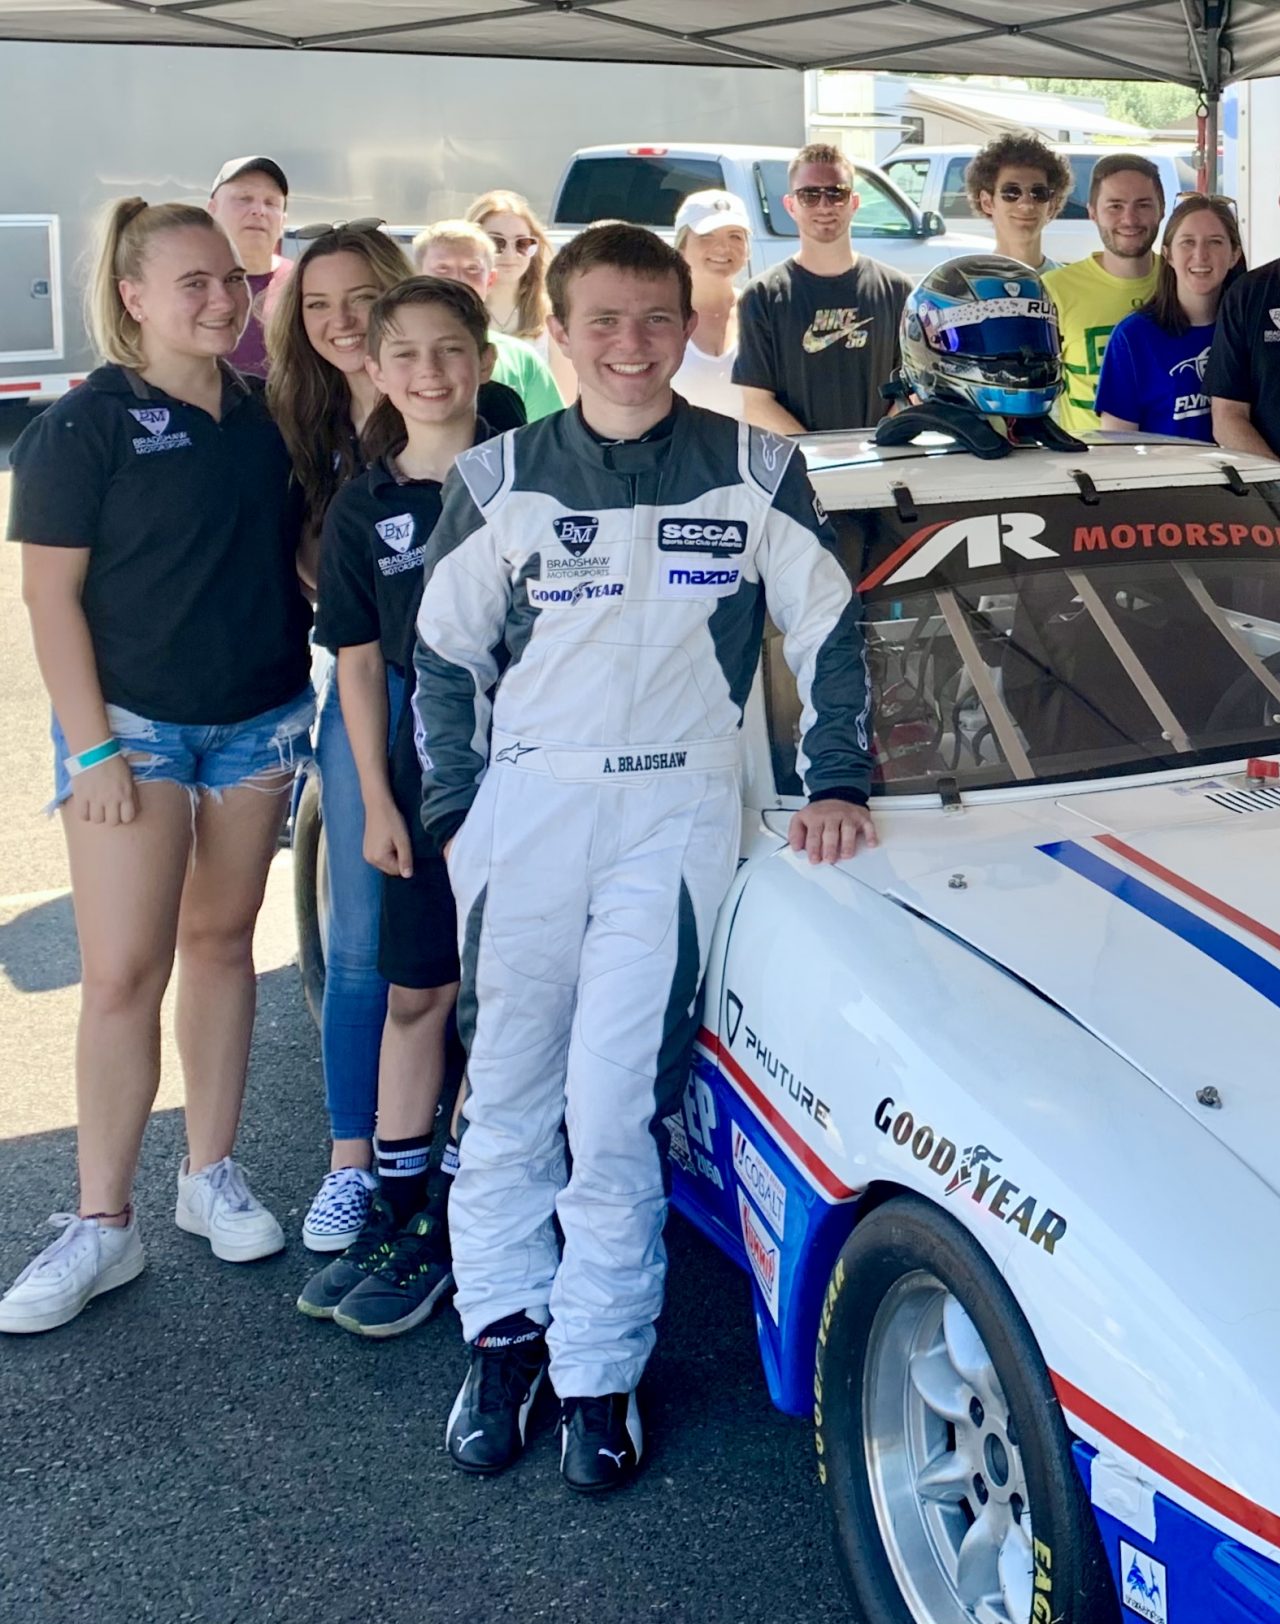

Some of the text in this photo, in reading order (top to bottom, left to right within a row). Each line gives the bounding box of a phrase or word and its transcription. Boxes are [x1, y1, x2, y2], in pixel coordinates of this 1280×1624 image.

[812, 308, 858, 331] NIKE
[845, 330, 868, 348] SB
[384, 522, 410, 540] BM
[560, 522, 592, 543] BM
[662, 524, 743, 541] SCCA
[883, 512, 1061, 586] AR
[382, 559, 424, 576] MOTORSPO
[547, 557, 610, 568] BRADSHAW
[547, 569, 610, 578] MOTORSPORTS
[603, 751, 688, 773] A. BRADSHAW
[745, 1025, 831, 1131] PHUTURE
[1033, 1536, 1052, 1624] EAG
